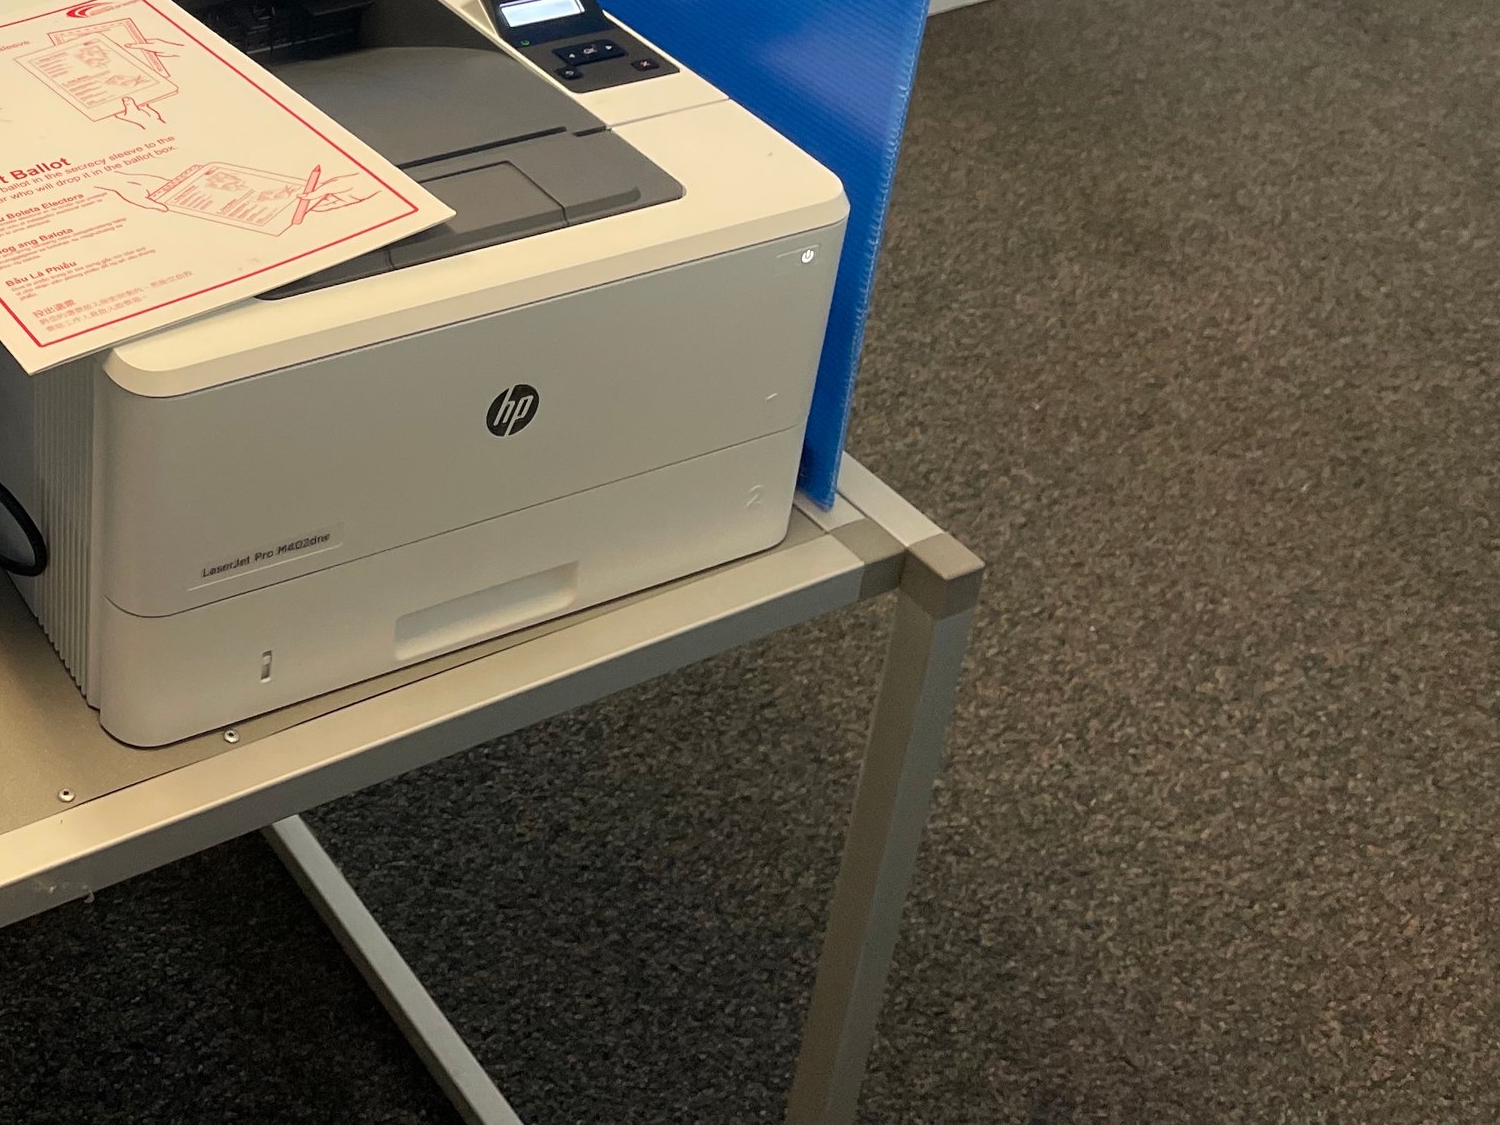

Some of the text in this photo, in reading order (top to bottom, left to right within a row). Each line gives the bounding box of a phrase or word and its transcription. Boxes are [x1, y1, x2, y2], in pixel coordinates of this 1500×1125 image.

[9, 157, 72, 180] Ballot
[488, 385, 537, 437] hp
[202, 556, 251, 578] LaserJet
[254, 550, 274, 562] Pro
